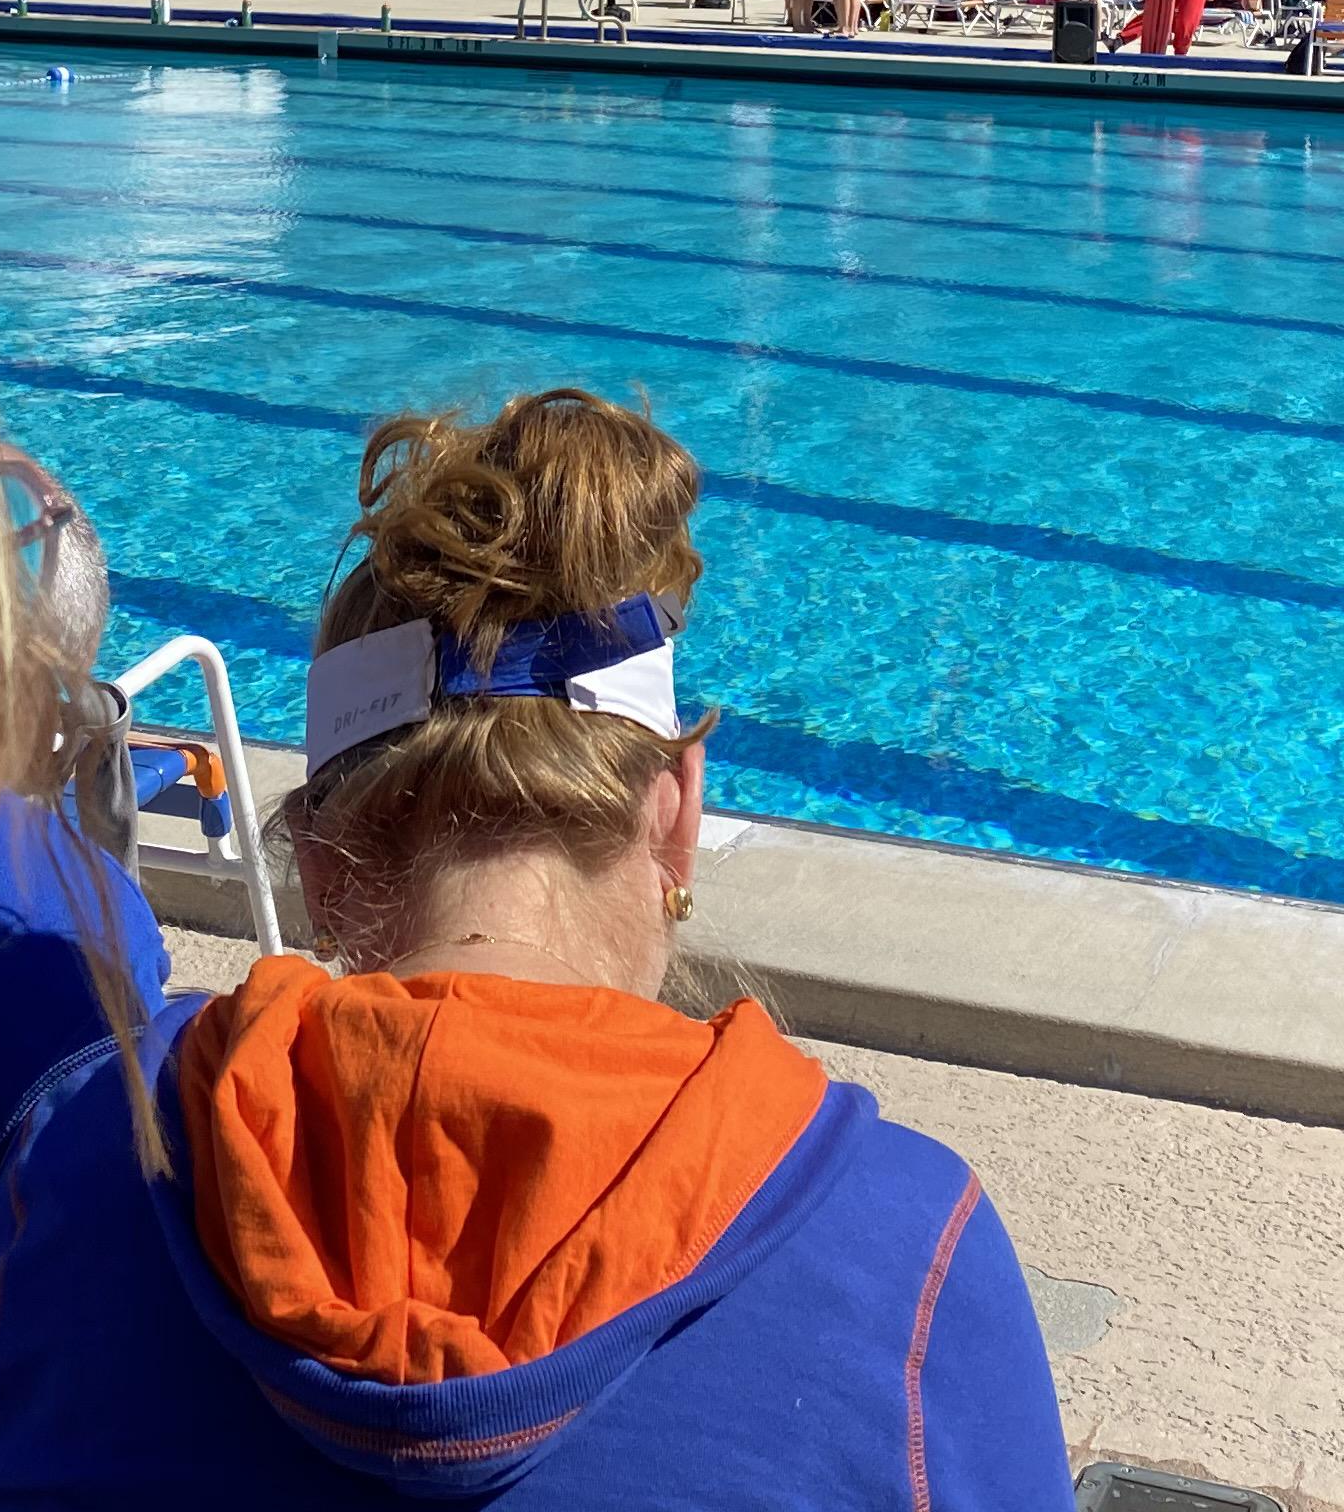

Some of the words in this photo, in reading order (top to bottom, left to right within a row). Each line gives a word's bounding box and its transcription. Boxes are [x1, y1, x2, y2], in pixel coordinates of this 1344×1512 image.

[1132, 73, 1150, 86] 2.4
[1156, 74, 1166, 87] M
[333, 691, 402, 733] DRI-FIT
